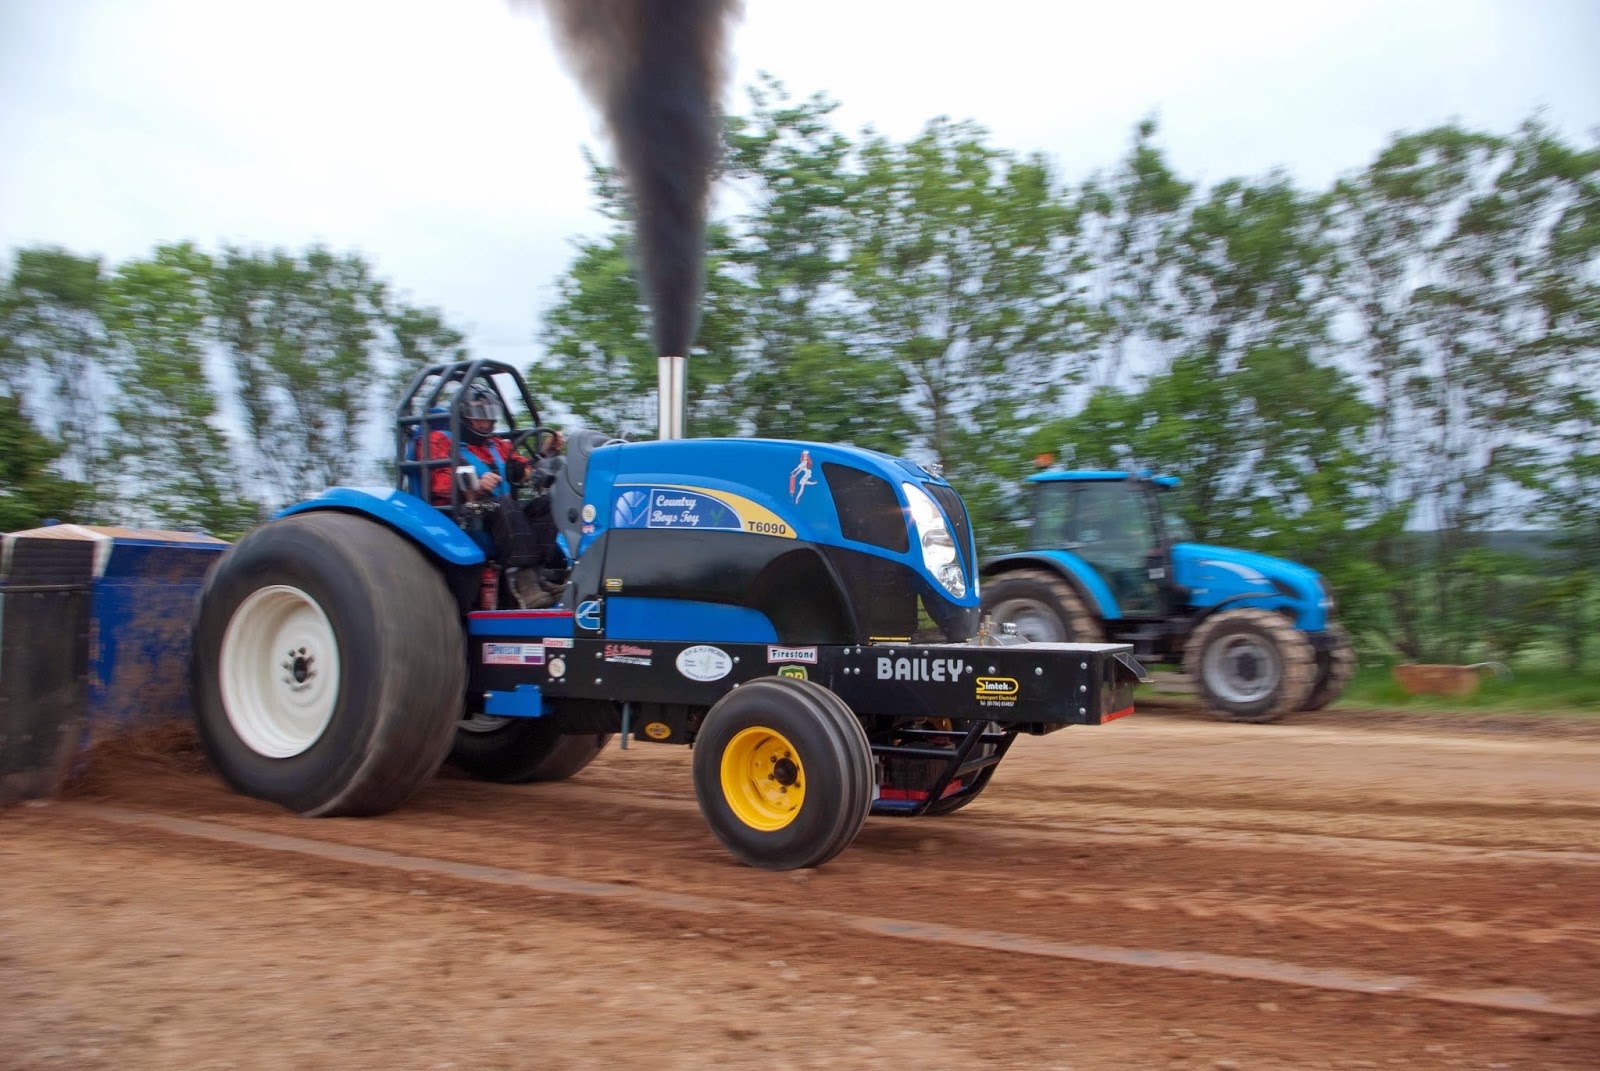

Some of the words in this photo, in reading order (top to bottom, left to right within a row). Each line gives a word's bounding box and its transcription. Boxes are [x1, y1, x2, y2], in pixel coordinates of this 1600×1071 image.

[656, 494, 697, 511] Country
[651, 510, 678, 526] Boys
[680, 510, 700, 527] Toy
[748, 521, 786, 535] T6090
[771, 649, 814, 659] Firestone
[877, 657, 964, 682] BAILEY
[976, 677, 1018, 694] Simtek
